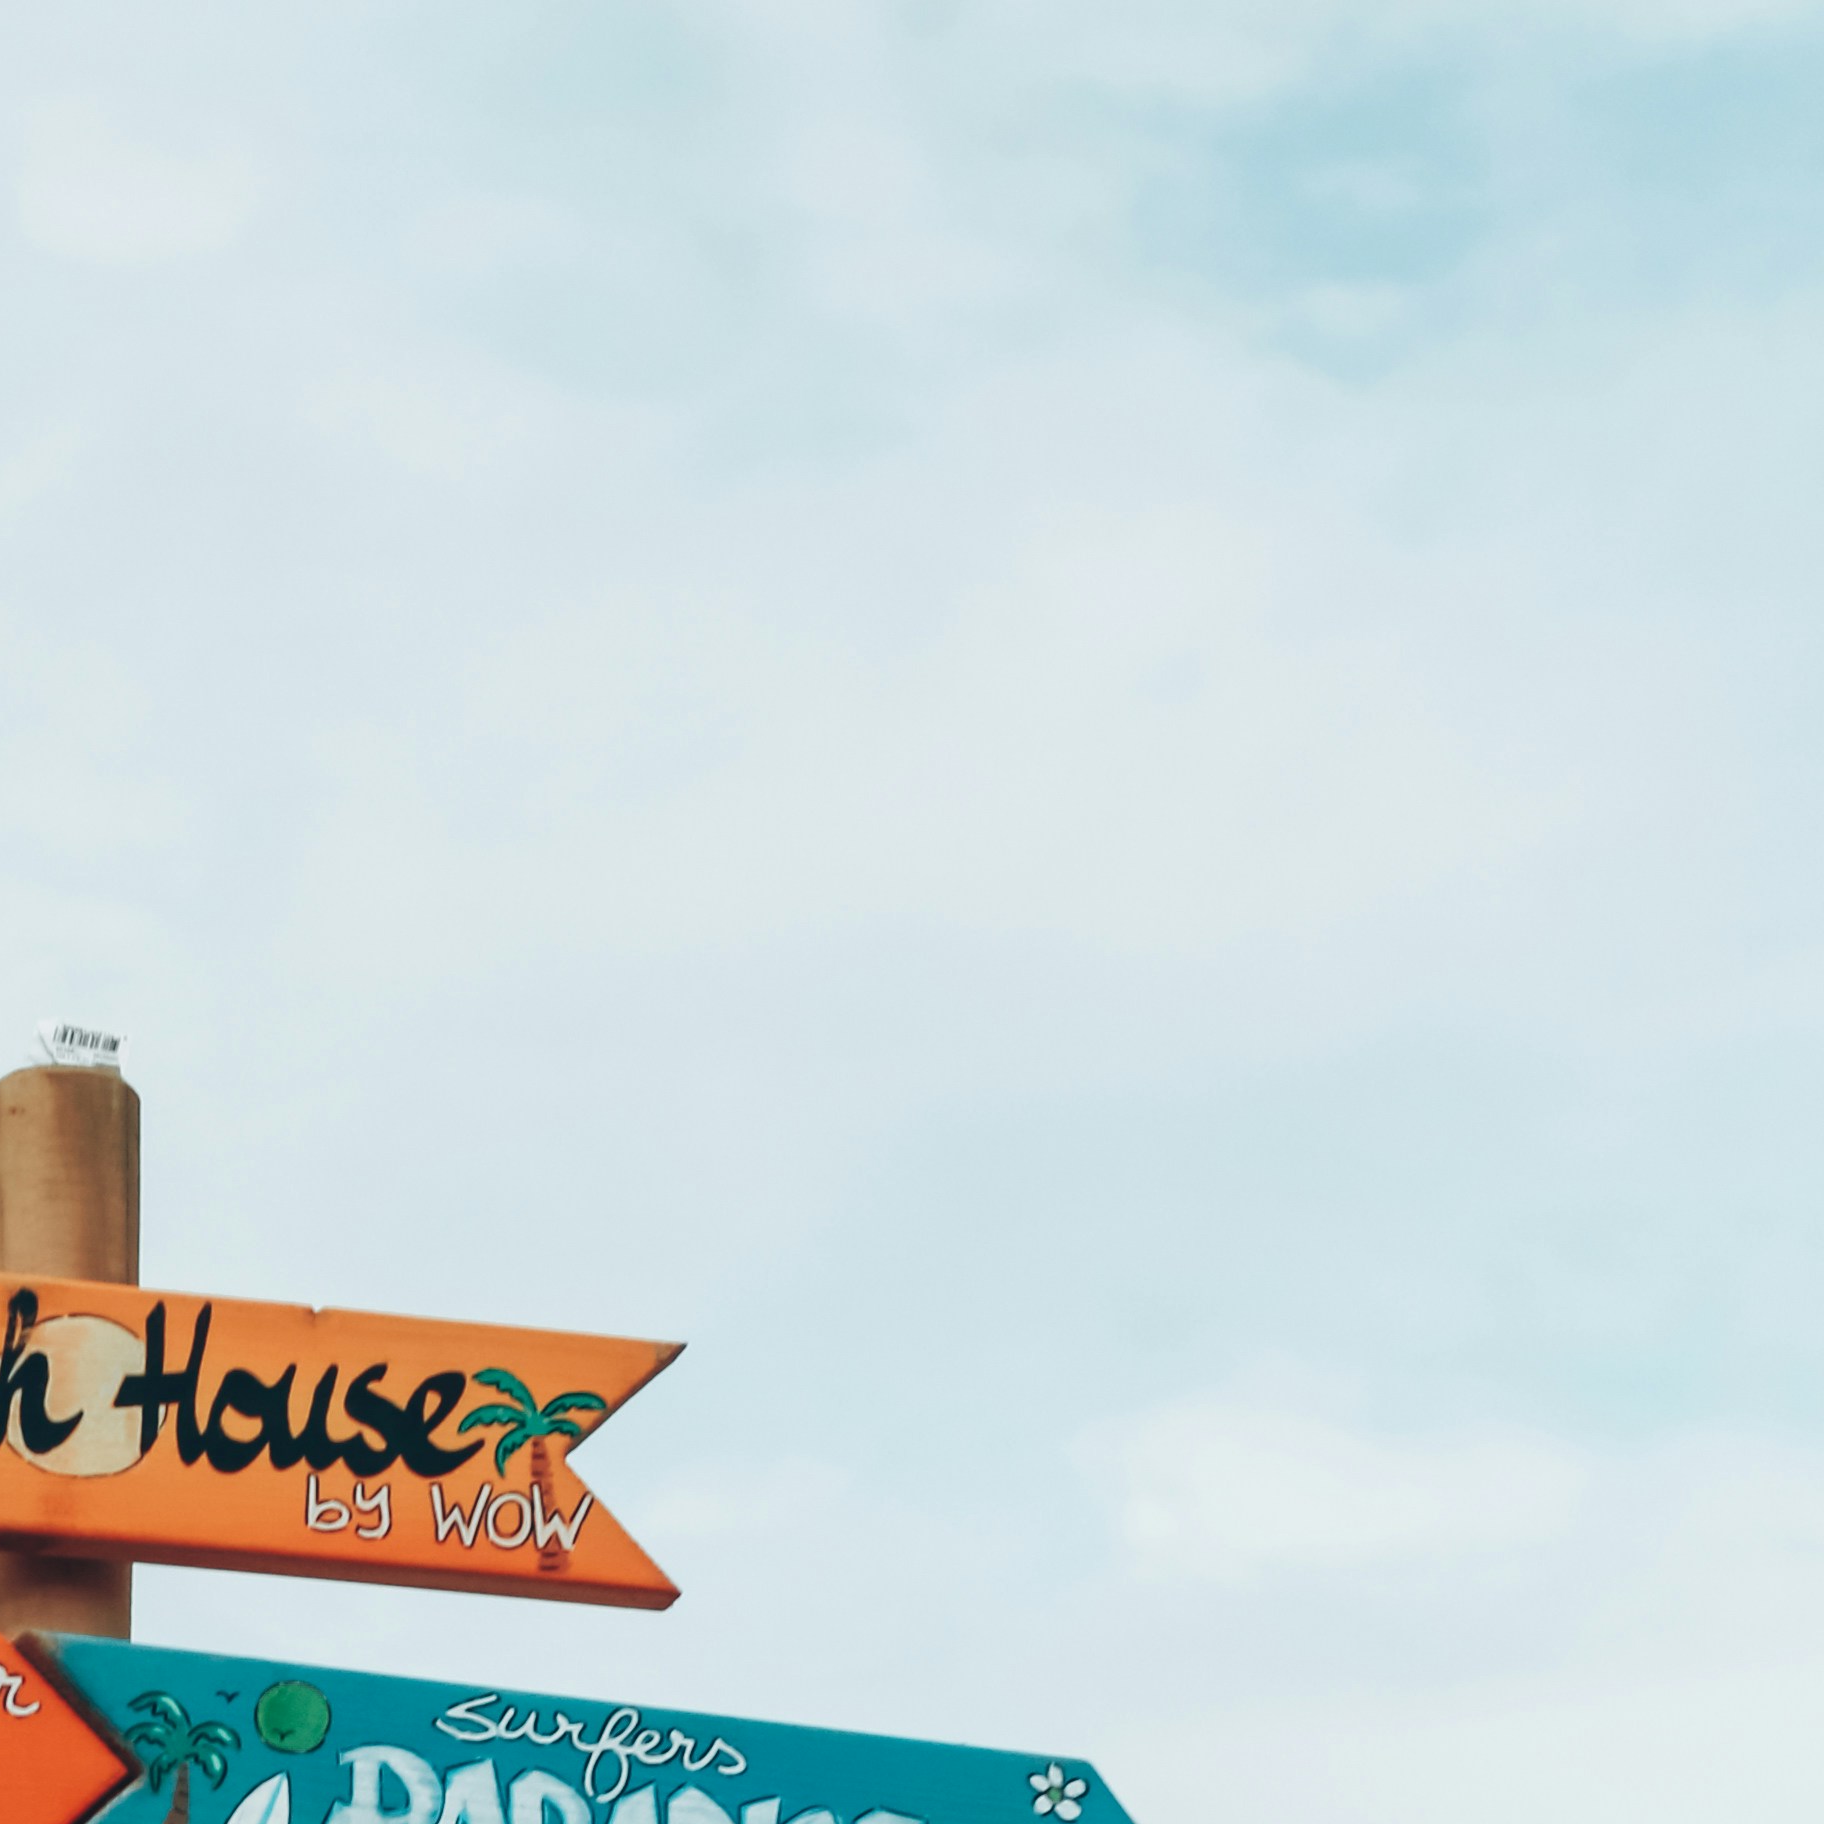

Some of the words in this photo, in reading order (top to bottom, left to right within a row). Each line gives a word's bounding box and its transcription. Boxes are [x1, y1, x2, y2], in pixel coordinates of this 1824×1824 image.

[111, 1298, 490, 1475] House
[304, 1477, 393, 1540] by
[430, 1484, 595, 1551] WOW
